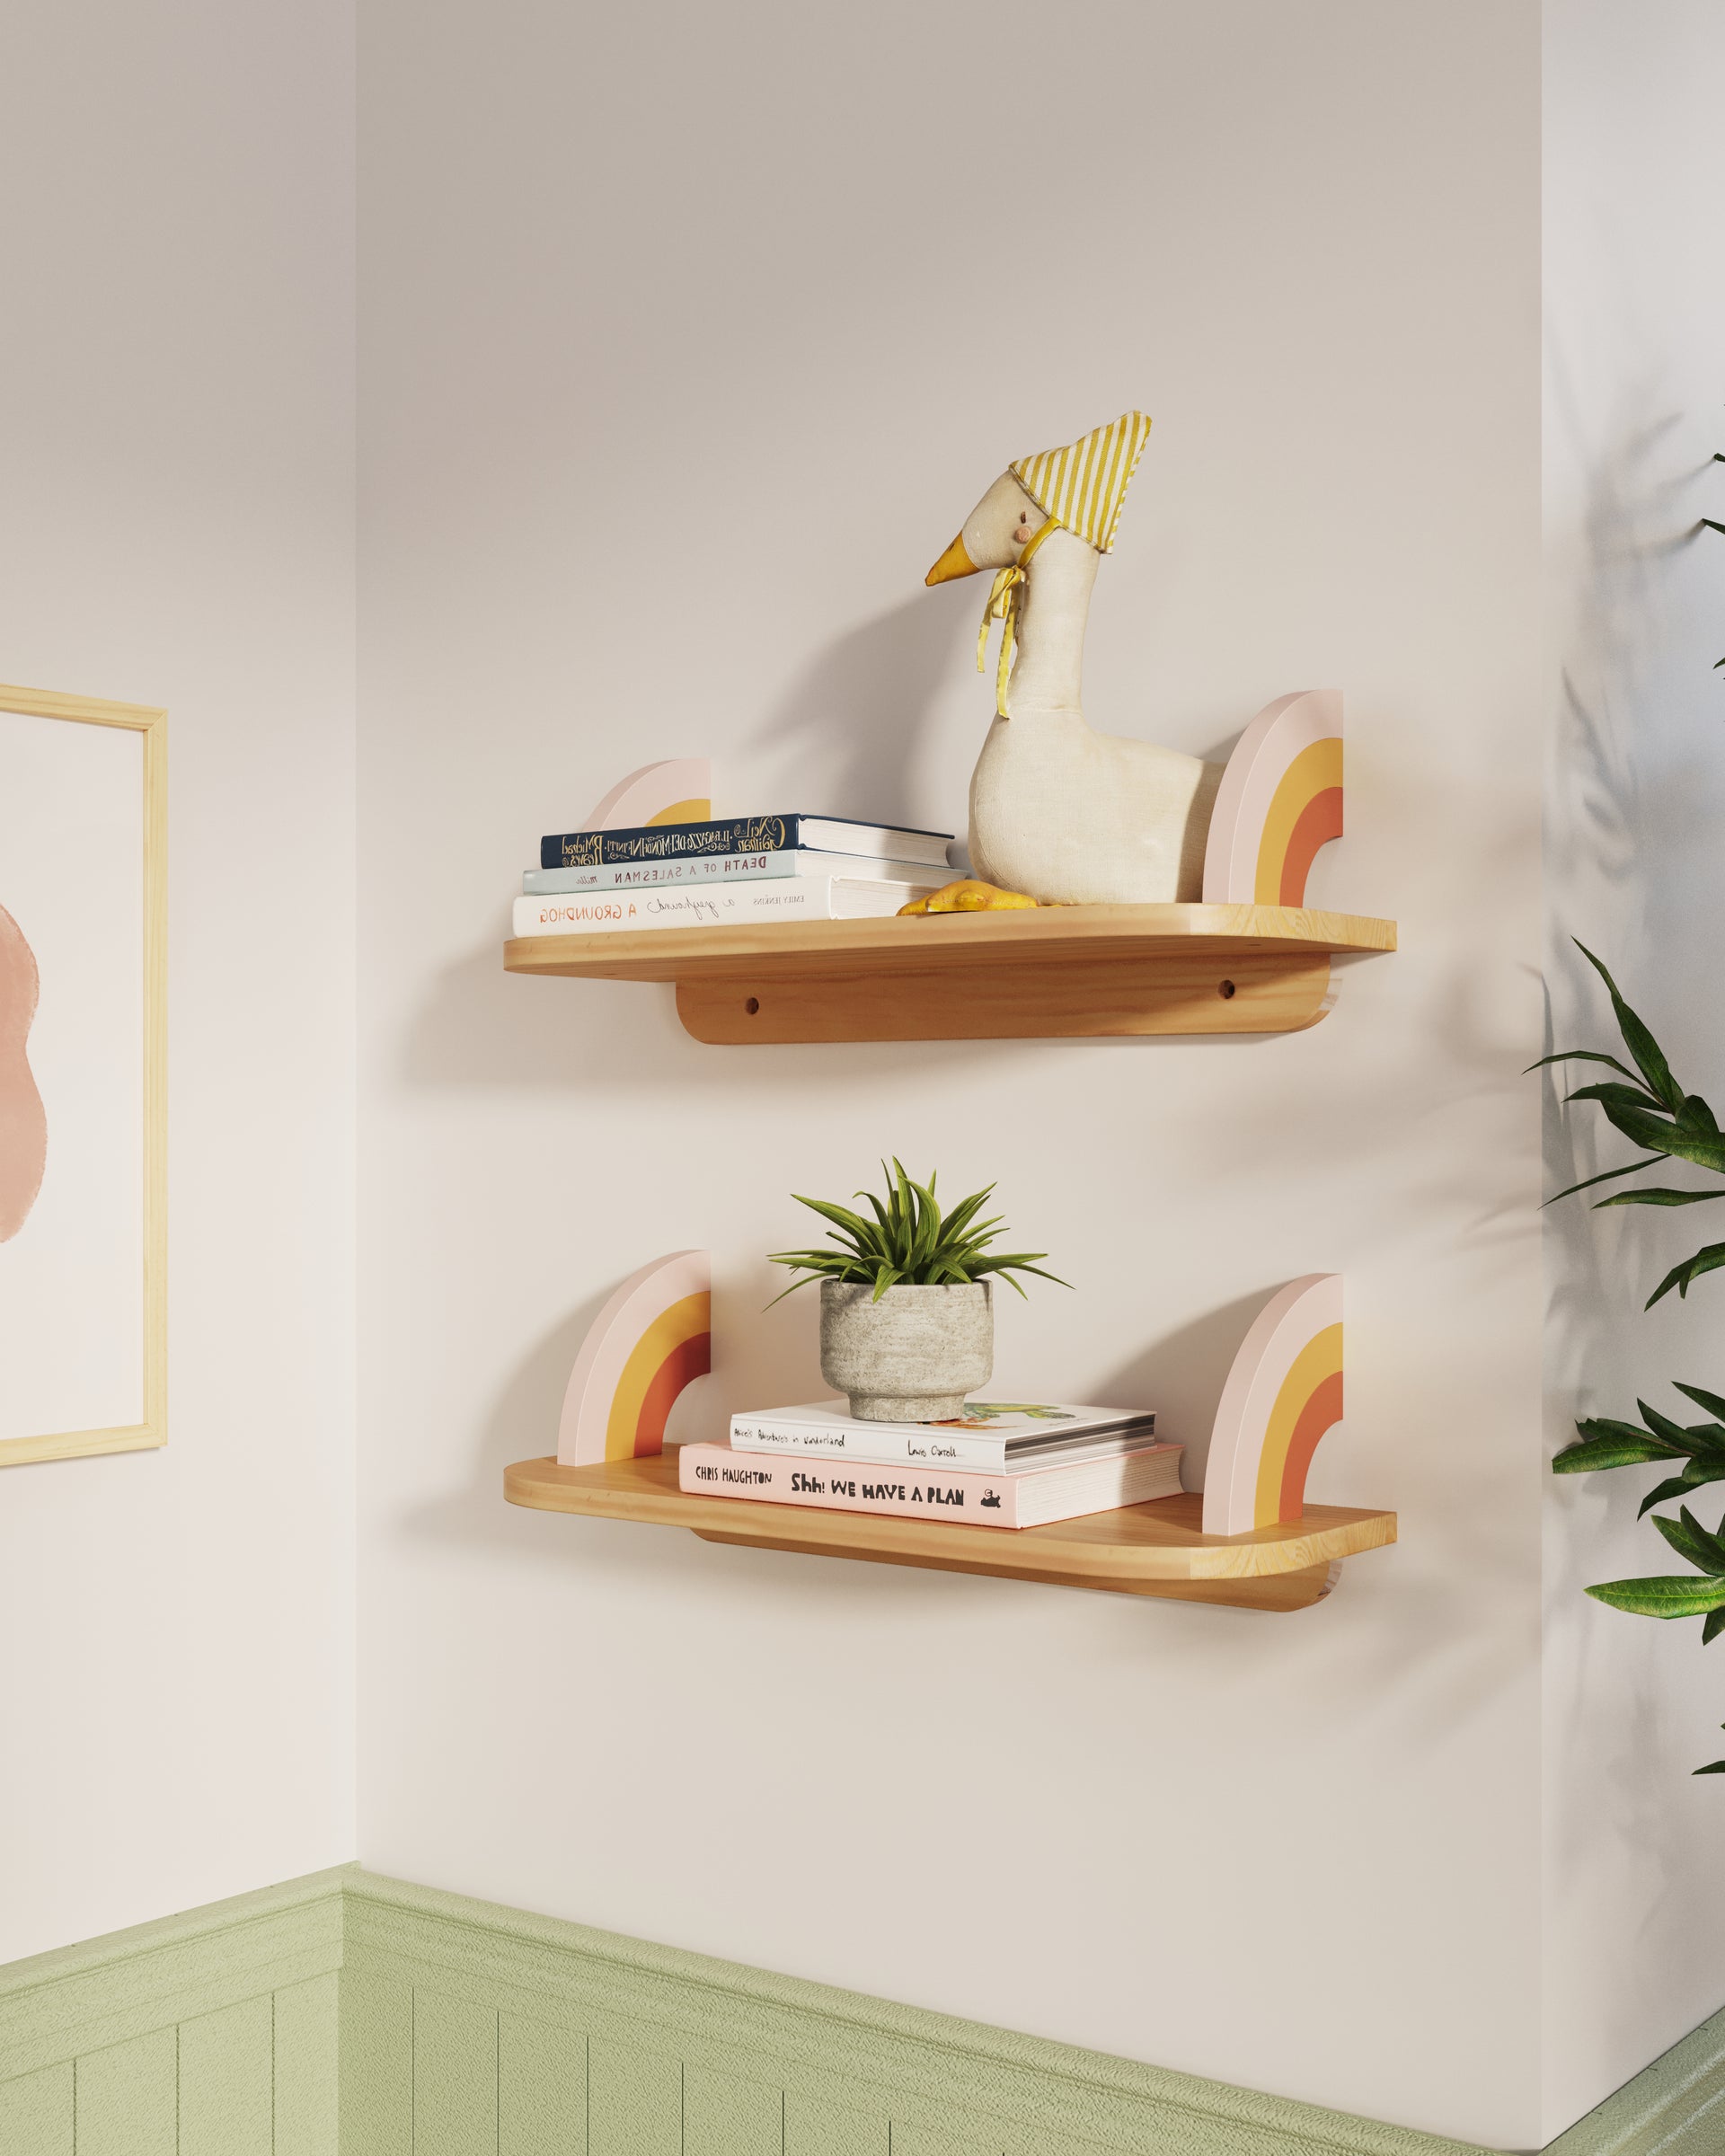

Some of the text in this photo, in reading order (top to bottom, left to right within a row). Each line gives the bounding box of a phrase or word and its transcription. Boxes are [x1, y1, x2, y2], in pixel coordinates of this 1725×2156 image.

[907, 1439, 957, 1458] Lewis Carroll
[695, 1466, 772, 1484] CHRIS HAUGHTON
[792, 1473, 964, 1506] Shh! WE HAVE A PLAN
